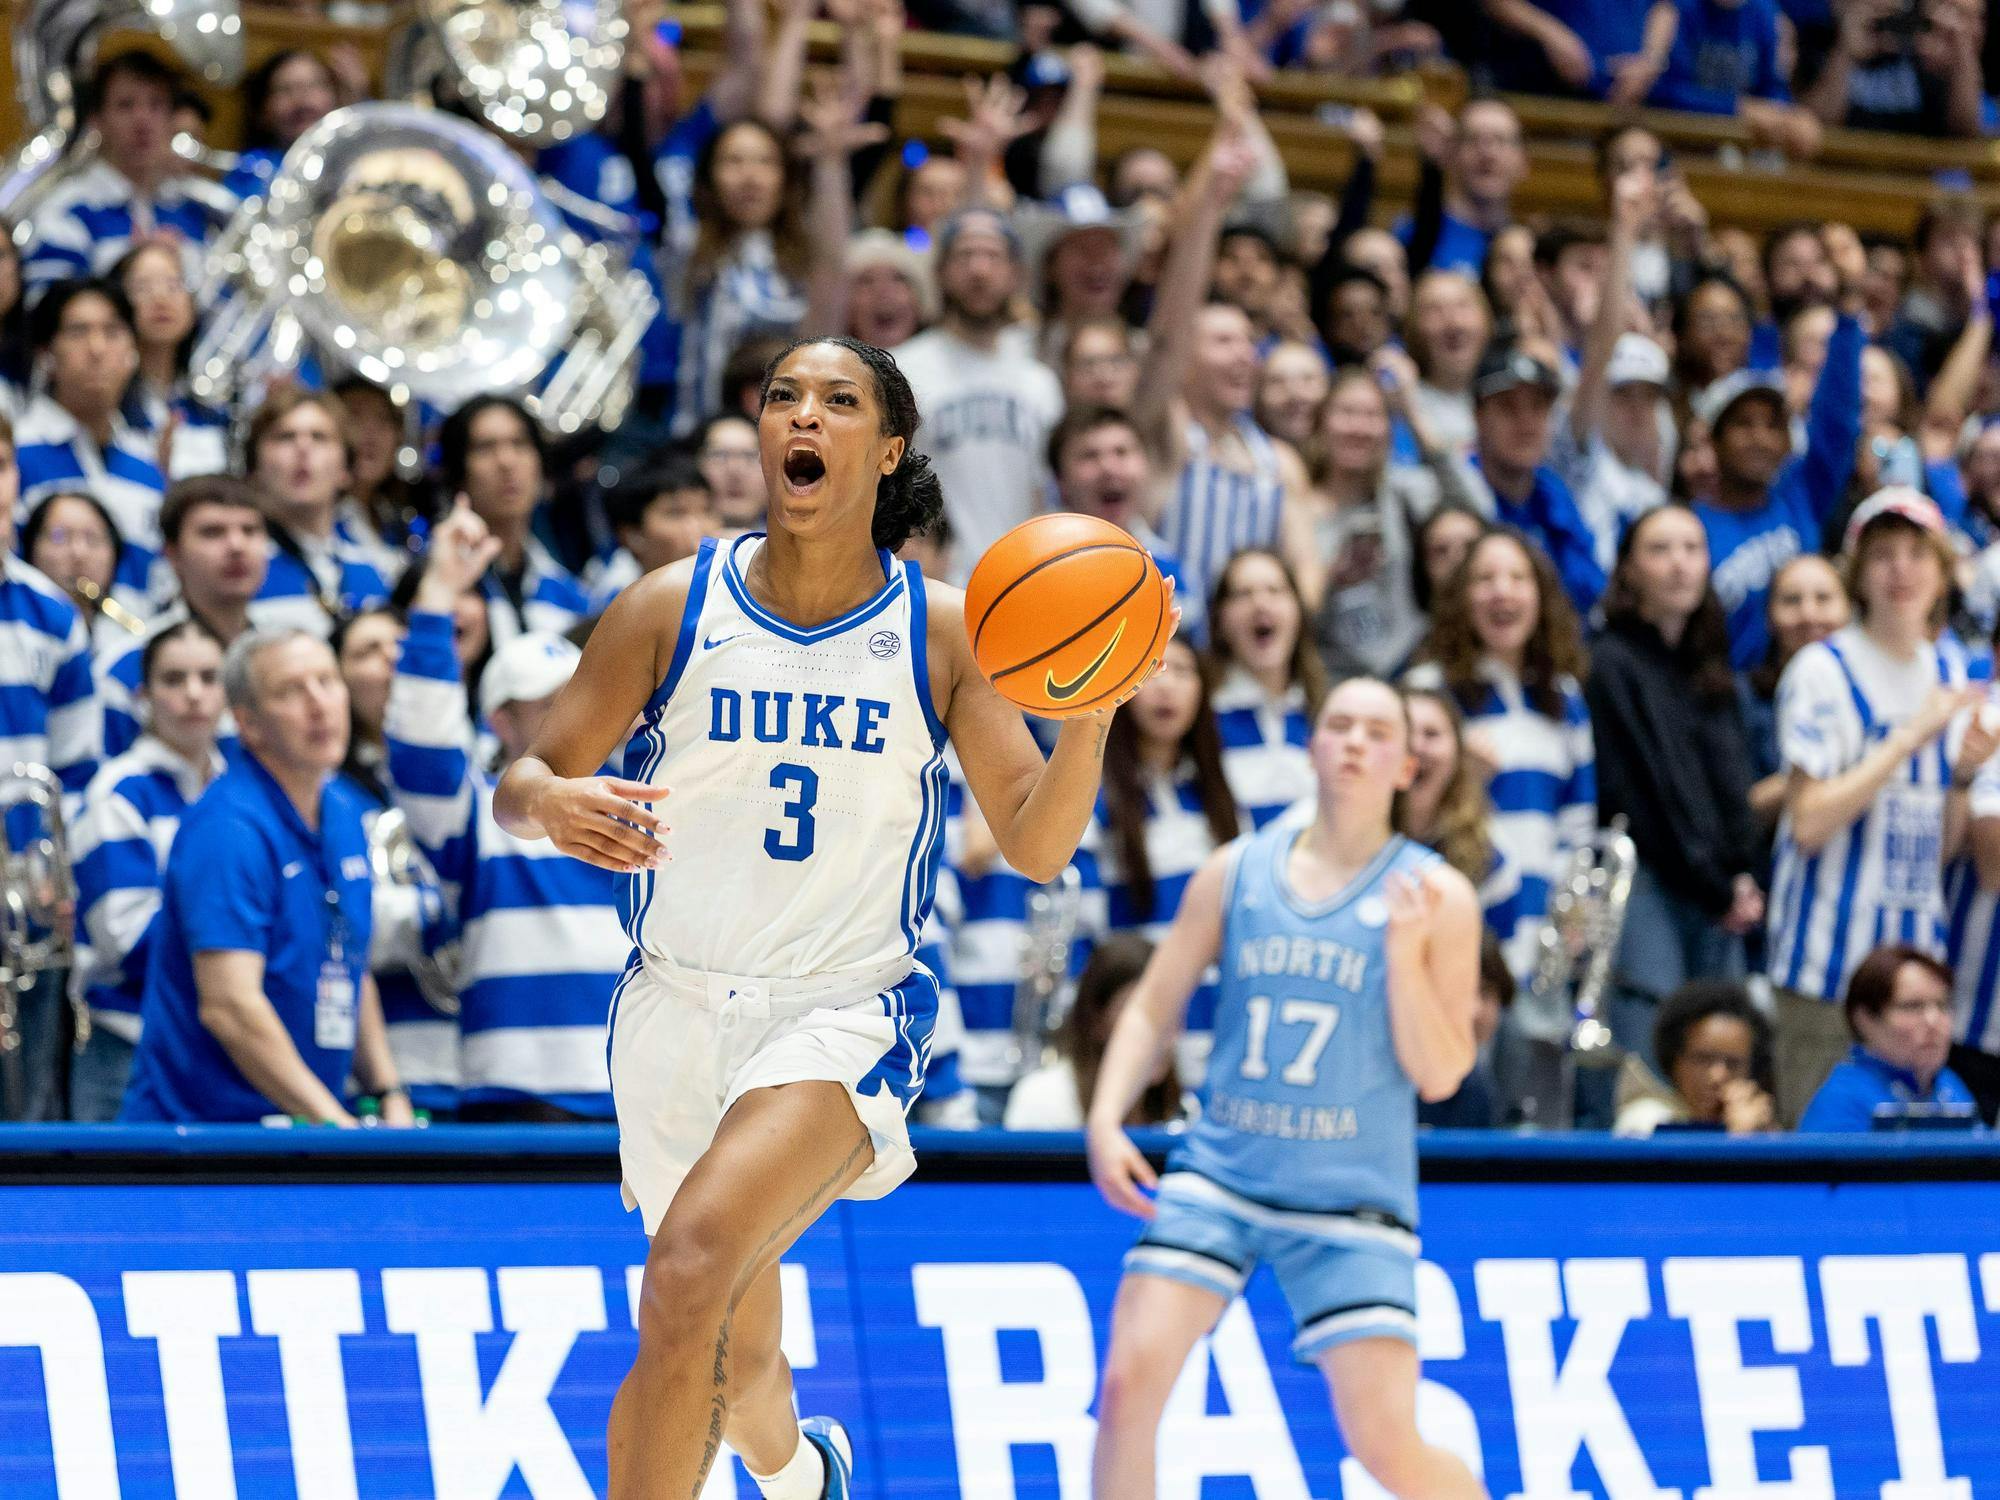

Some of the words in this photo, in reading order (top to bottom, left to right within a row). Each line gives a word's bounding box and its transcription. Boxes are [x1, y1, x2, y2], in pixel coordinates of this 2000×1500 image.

[708, 687, 891, 754] DUKE
[763, 762, 819, 862] 3
[1238, 935, 1367, 993] NORTH
[1240, 996, 1340, 1086] 17
[911, 1253, 2000, 1500] BAKET
